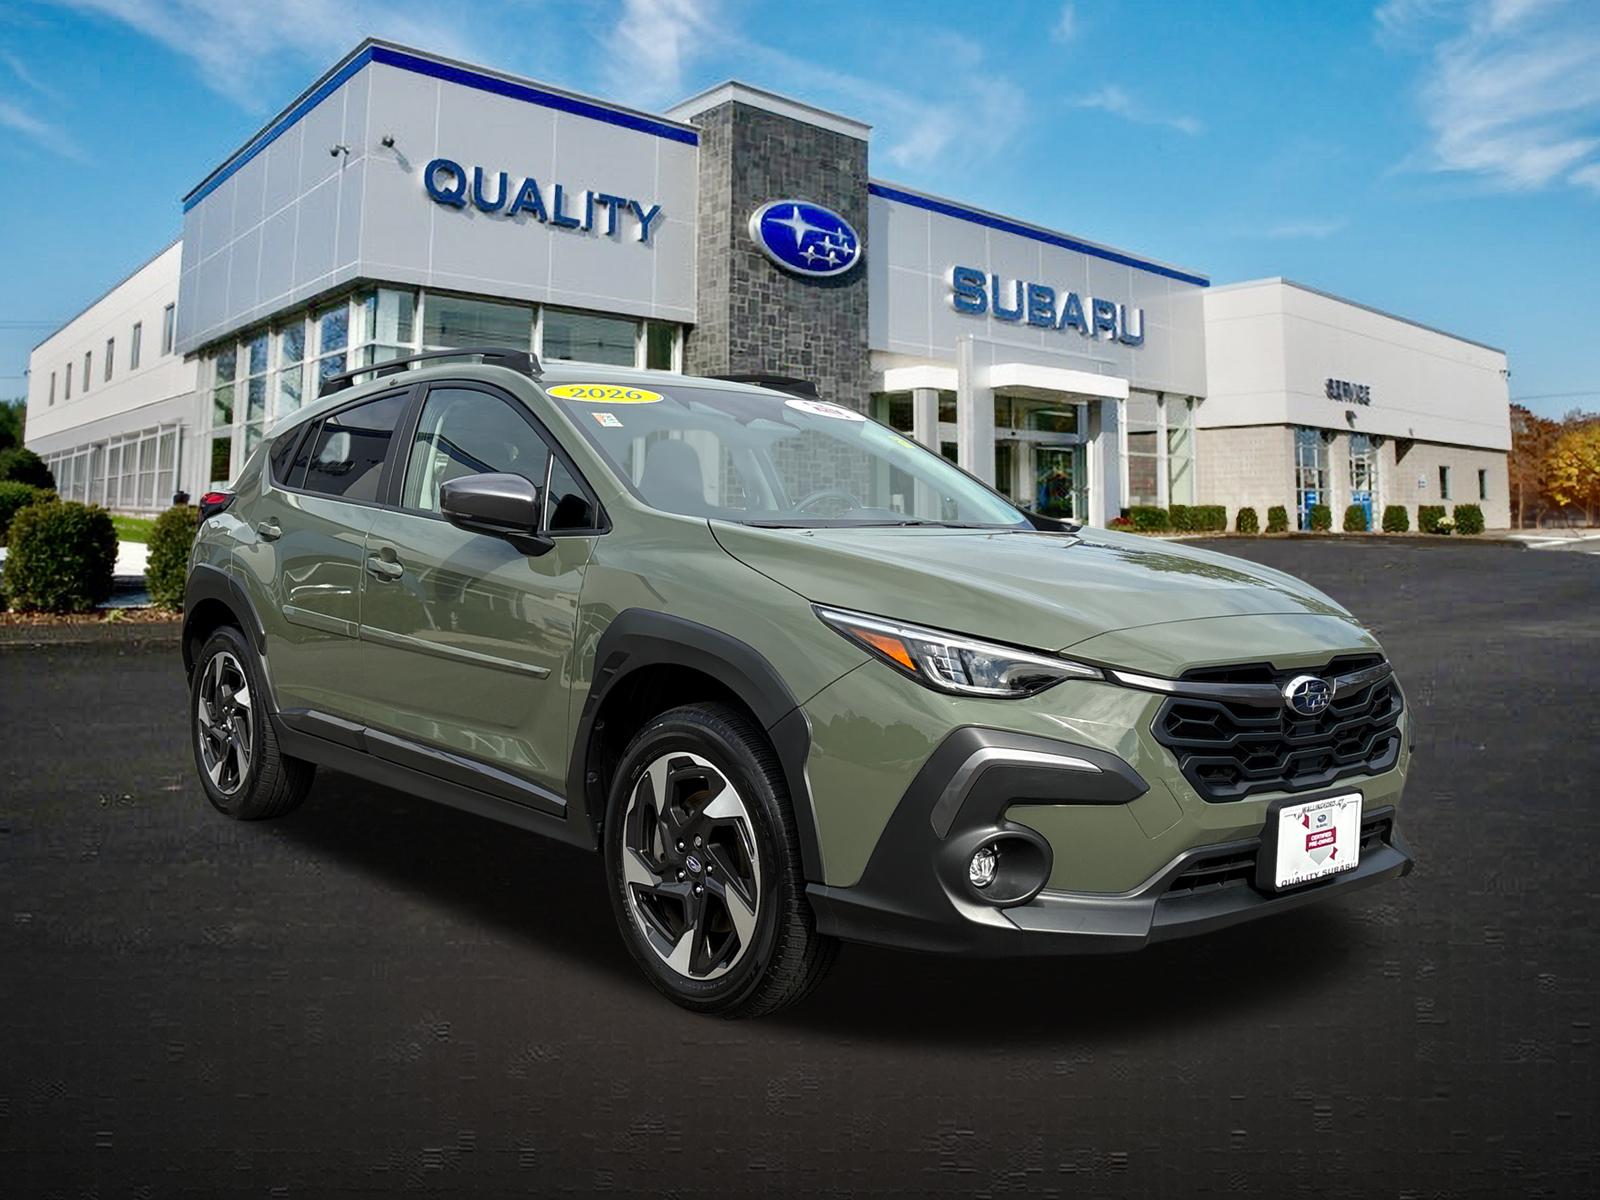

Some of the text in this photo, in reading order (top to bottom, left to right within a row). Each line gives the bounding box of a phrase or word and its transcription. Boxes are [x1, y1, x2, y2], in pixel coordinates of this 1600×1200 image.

[424, 159, 661, 241] QUALITY
[951, 266, 1144, 346] SUBARU
[569, 387, 642, 400] 2026
[1326, 378, 1371, 406] SERVICE
[1281, 862, 1356, 887] QUALITY SUBARU
